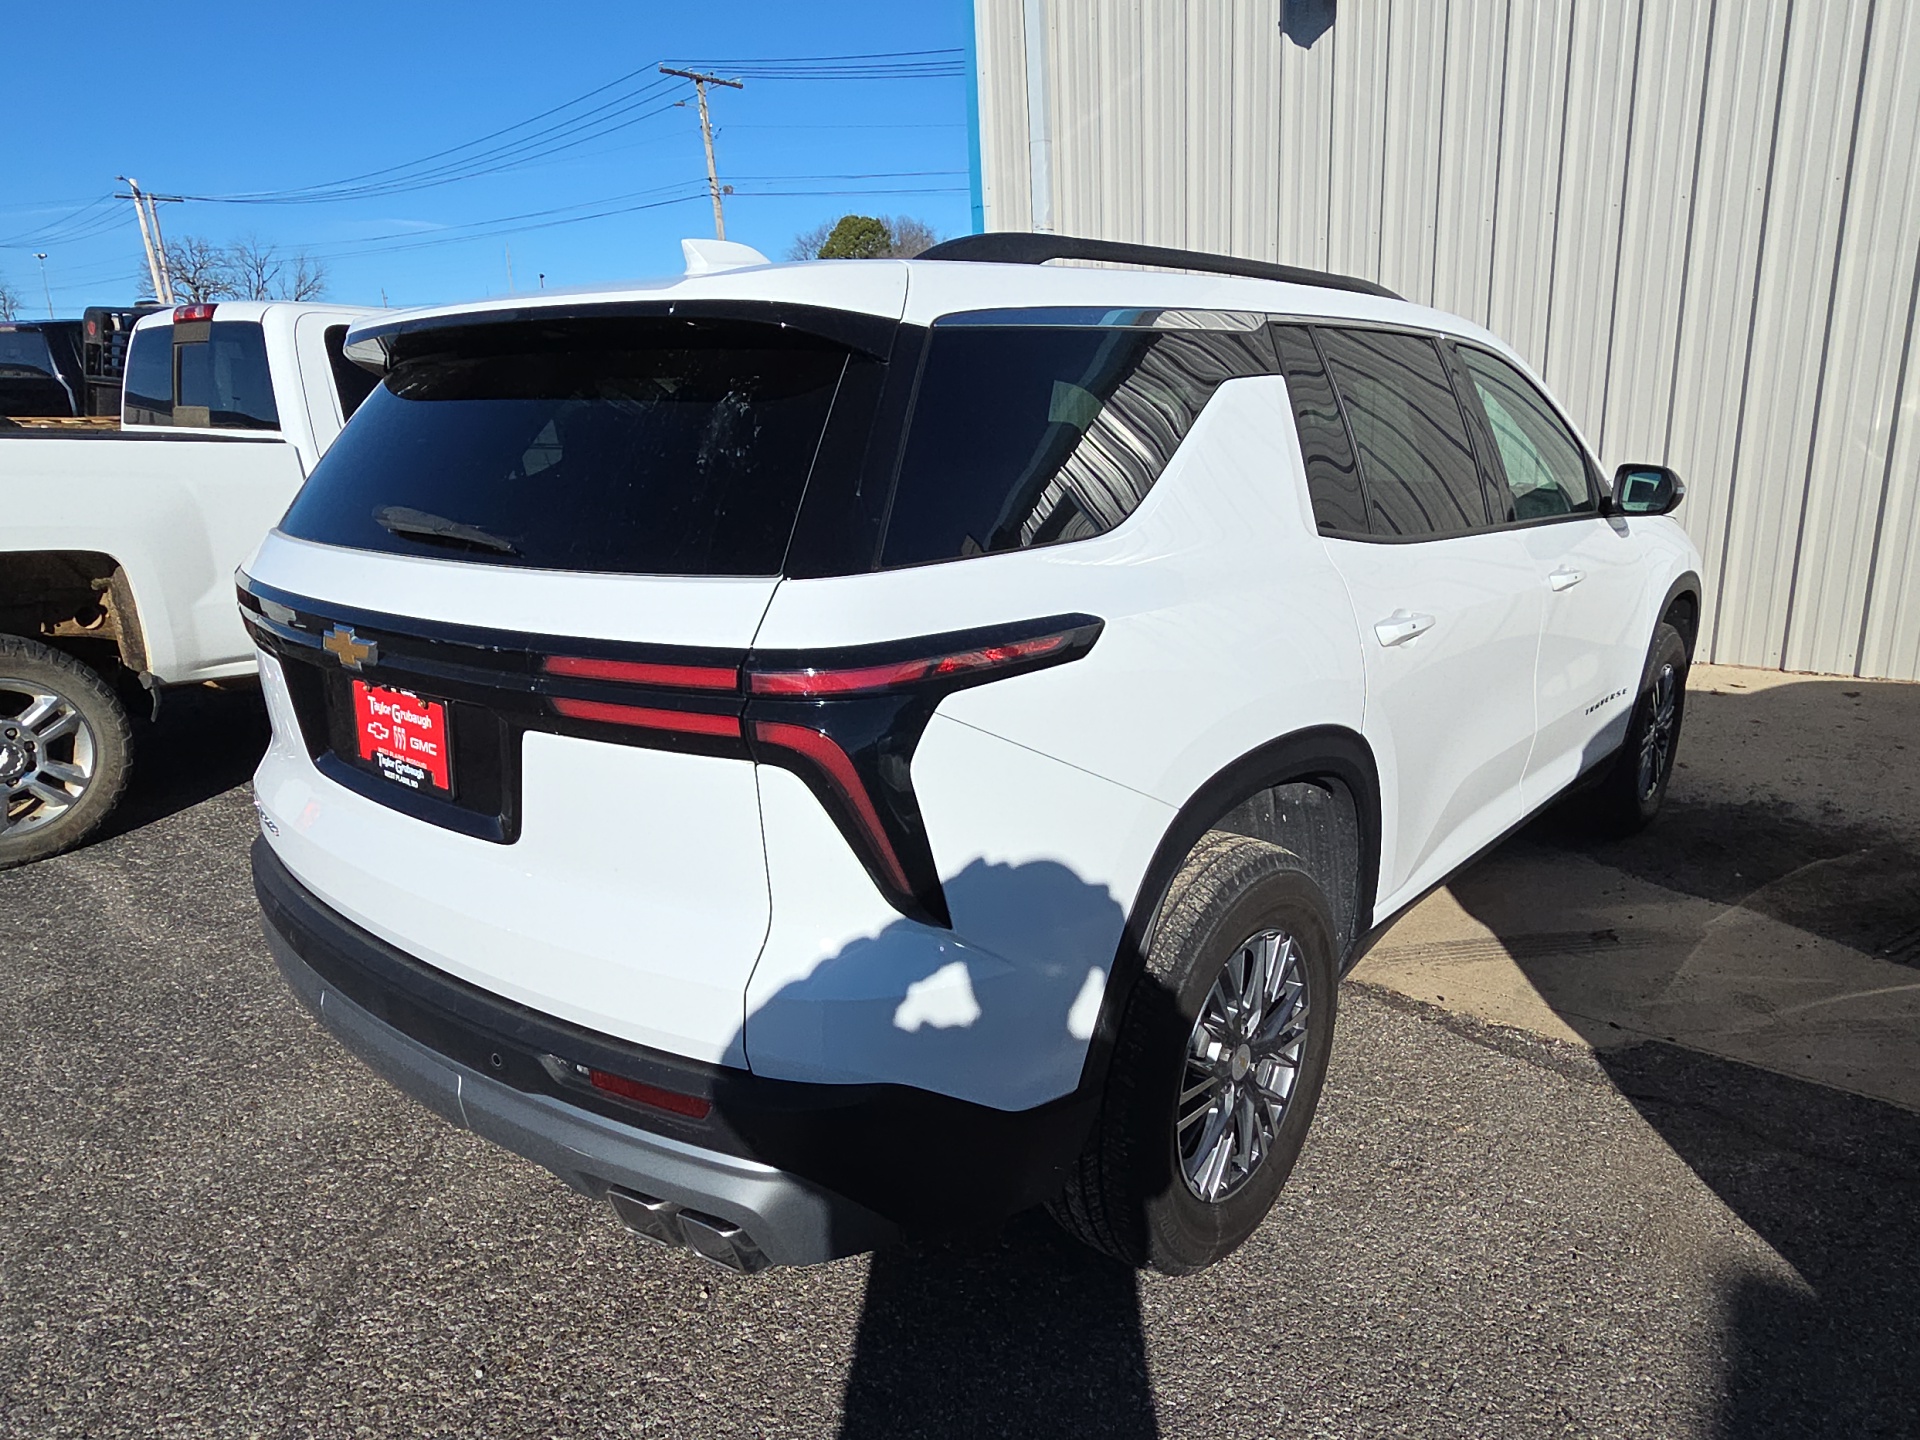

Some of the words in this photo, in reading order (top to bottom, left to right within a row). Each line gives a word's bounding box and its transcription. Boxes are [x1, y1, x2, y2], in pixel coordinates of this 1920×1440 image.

[367, 695, 391, 715] Taylor
[392, 704, 432, 729] Grubaugh
[1585, 687, 1628, 715] TRAVERSE
[410, 737, 437, 756] GMC
[376, 752, 394, 767] Taylor
[395, 759, 425, 780] Grubaugh
